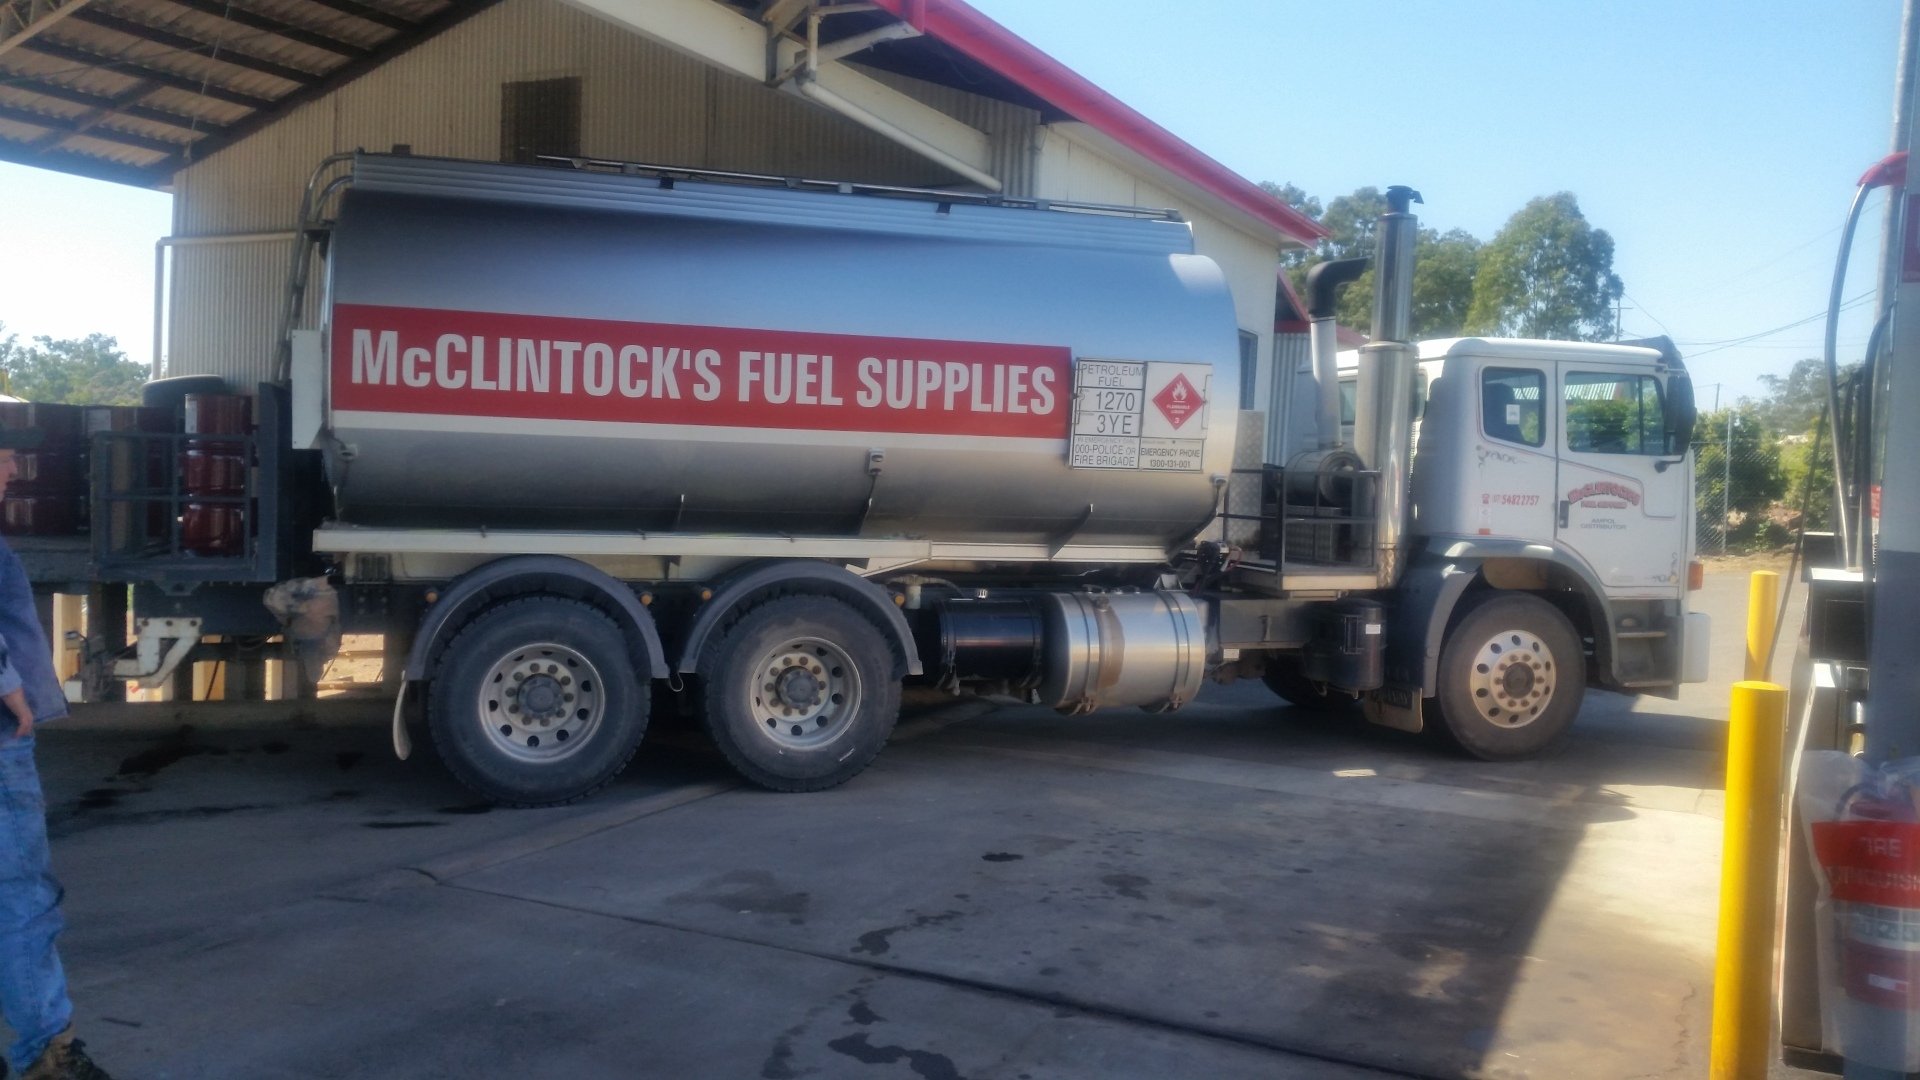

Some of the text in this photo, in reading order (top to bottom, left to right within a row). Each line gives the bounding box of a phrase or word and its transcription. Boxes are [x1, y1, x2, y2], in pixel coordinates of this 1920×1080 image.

[351, 328, 1056, 416] McCLINTOCK'S FUEL SUPPLIES
[1082, 363, 1143, 377] PETROLEUM
[1098, 376, 1125, 388] FUEL
[1096, 391, 1135, 412] 1270
[1141, 447, 1201, 458] EMERGENCY PHONE
[1074, 455, 1135, 467] FIRE BRIGADE
